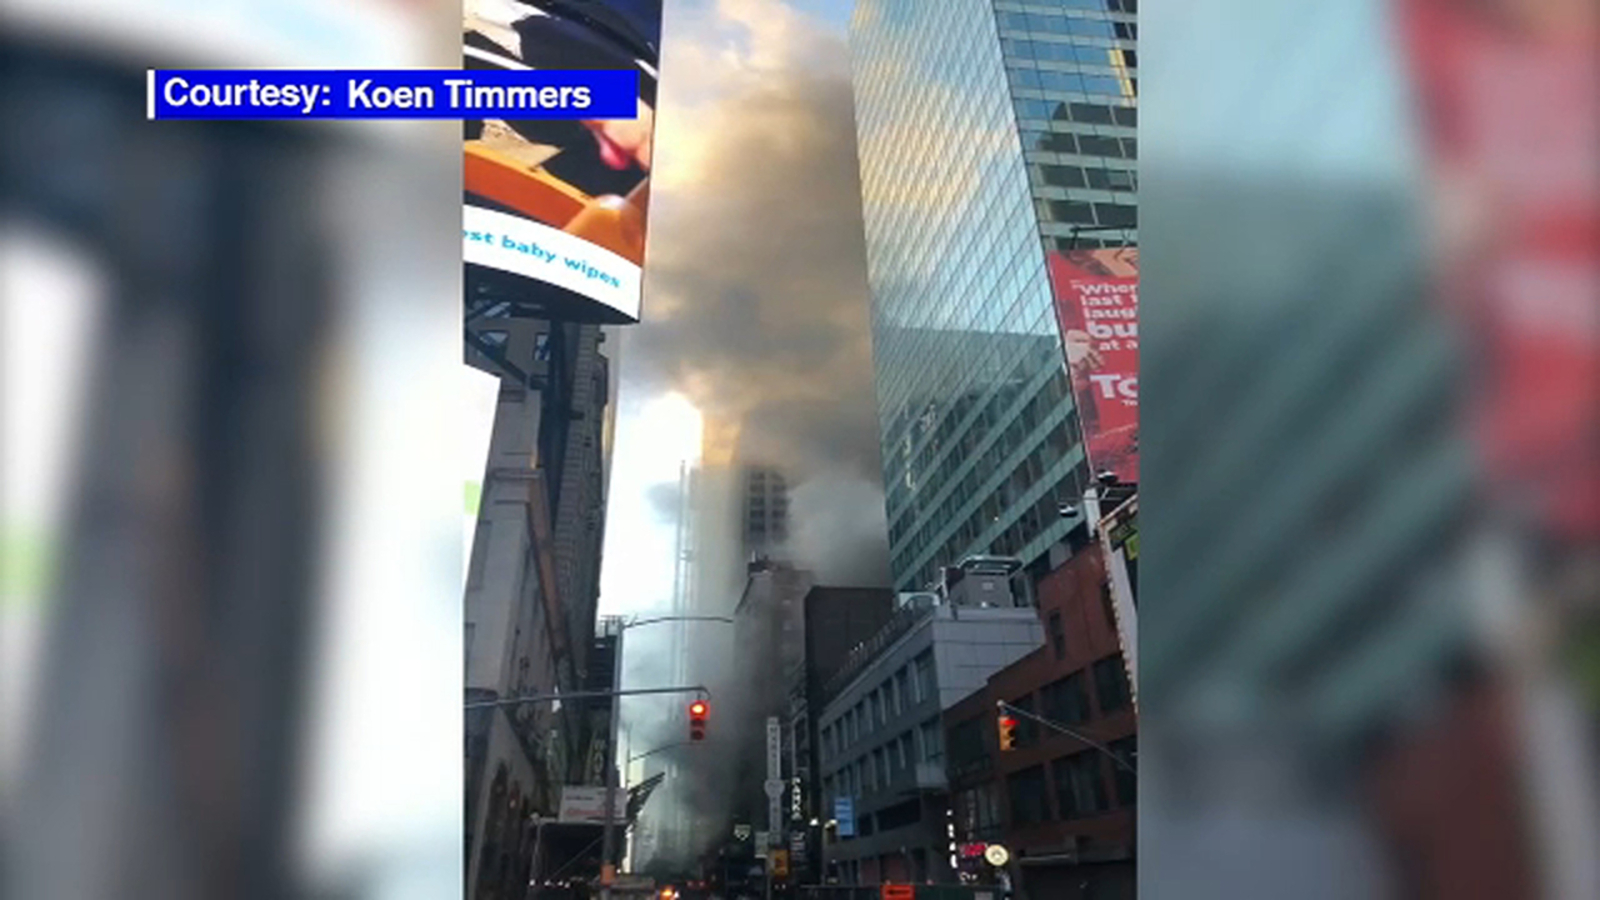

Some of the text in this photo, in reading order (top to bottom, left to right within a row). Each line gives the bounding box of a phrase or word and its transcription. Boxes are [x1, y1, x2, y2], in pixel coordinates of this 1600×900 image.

[502, 234, 556, 263] baby
[564, 256, 621, 288] wipes
[1080, 294, 1123, 306] last
[1099, 340, 1120, 351] at
